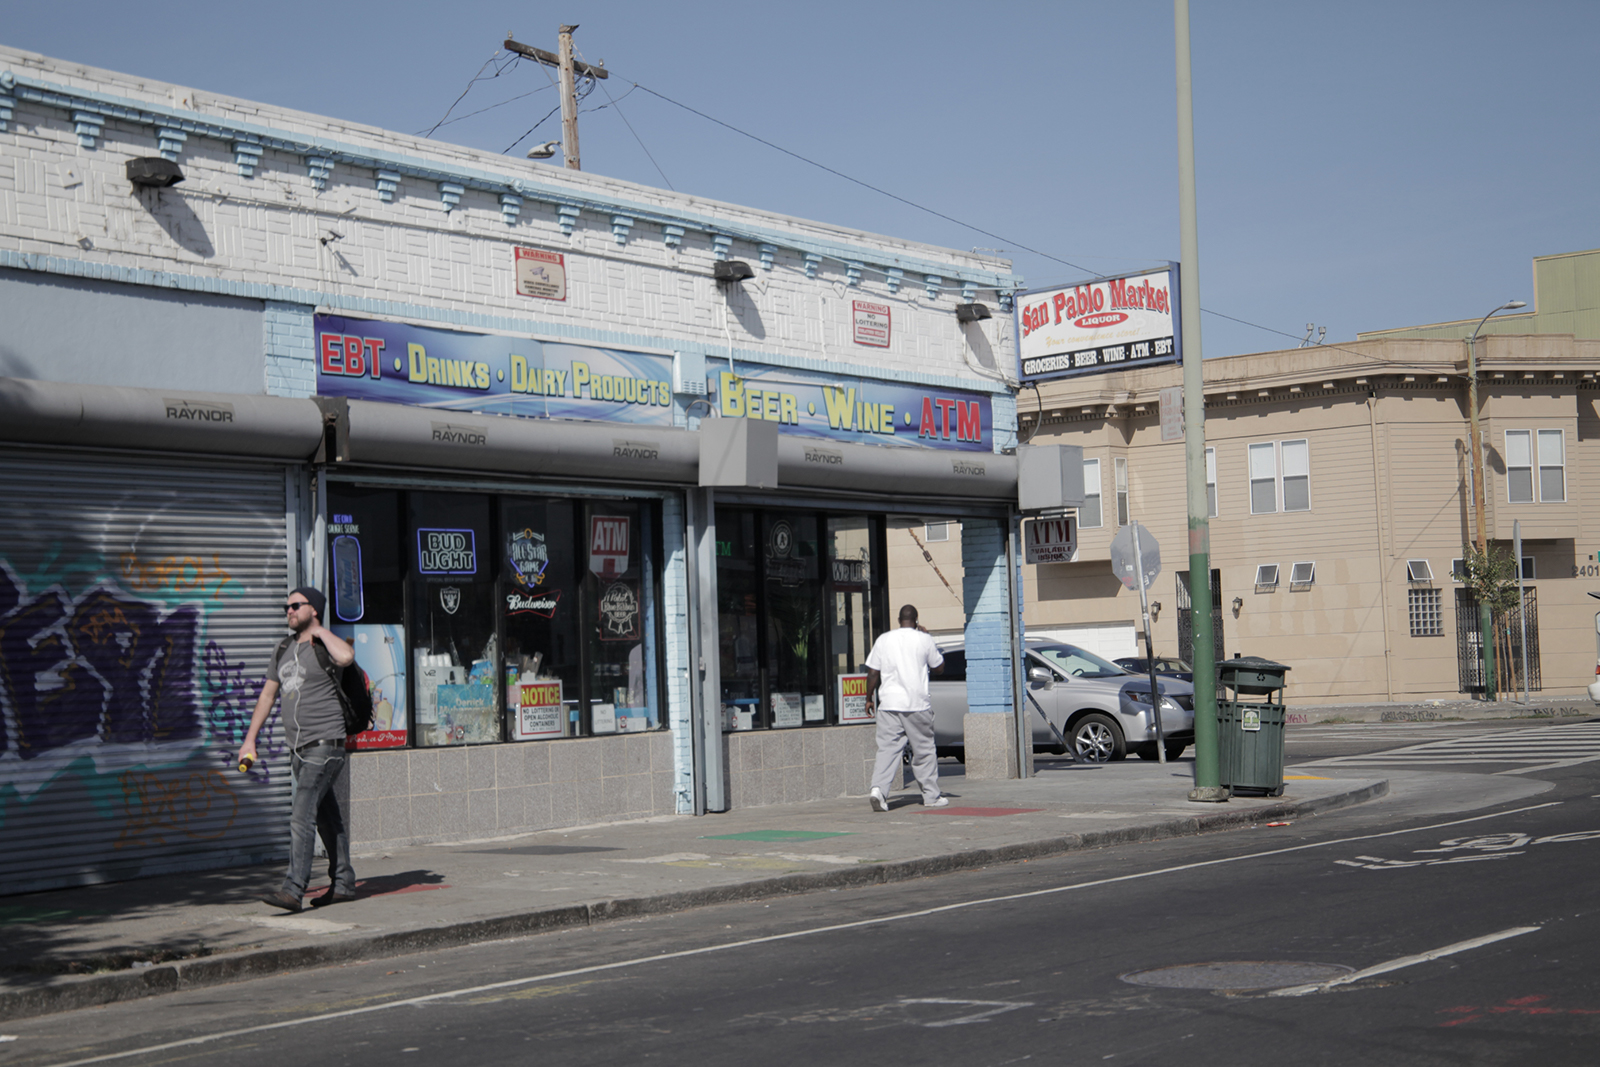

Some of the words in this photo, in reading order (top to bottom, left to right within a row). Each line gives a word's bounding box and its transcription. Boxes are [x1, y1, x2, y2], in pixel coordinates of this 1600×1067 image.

[522, 250, 557, 261] WARNING
[856, 302, 887, 313] WARNING
[1022, 302, 1049, 338] San
[1053, 284, 1104, 325] Pablo
[1109, 279, 1170, 314] Market
[855, 319, 888, 329] LOITERING
[1082, 314, 1120, 326] LIQUOR
[1045, 336, 1065, 348] Your
[1067, 332, 1113, 343] convenience
[1024, 355, 1069, 375] GROCERIES
[1074, 350, 1098, 367] BEER
[1103, 346, 1126, 363] WINE
[1131, 342, 1150, 359] ATM
[1155, 338, 1173, 355] EBT
[320, 332, 385, 379] EBT
[408, 342, 491, 391] DRINKS
[510, 353, 568, 397] DAIRY
[571, 360, 671, 407] PRODUCTS
[165, 406, 234, 423] RAYNOR
[719, 371, 798, 425] BEER
[822, 385, 895, 434] WINE
[919, 396, 981, 443] ATM
[432, 430, 486, 446] RAYNOR
[613, 446, 658, 460] RAYNOR
[805, 452, 843, 465] RAYNOR
[953, 463, 986, 476] RAYNOR
[593, 521, 627, 551] ATM
[1031, 520, 1070, 545] ATM
[428, 533, 466, 551] BUD
[421, 551, 474, 569] LIGHT
[519, 561, 539, 573] GAME
[832, 562, 849, 582] We
[1572, 565, 1600, 577] 2401
[507, 594, 556, 610] Budweiser
[521, 687, 560, 705] NOTICE
